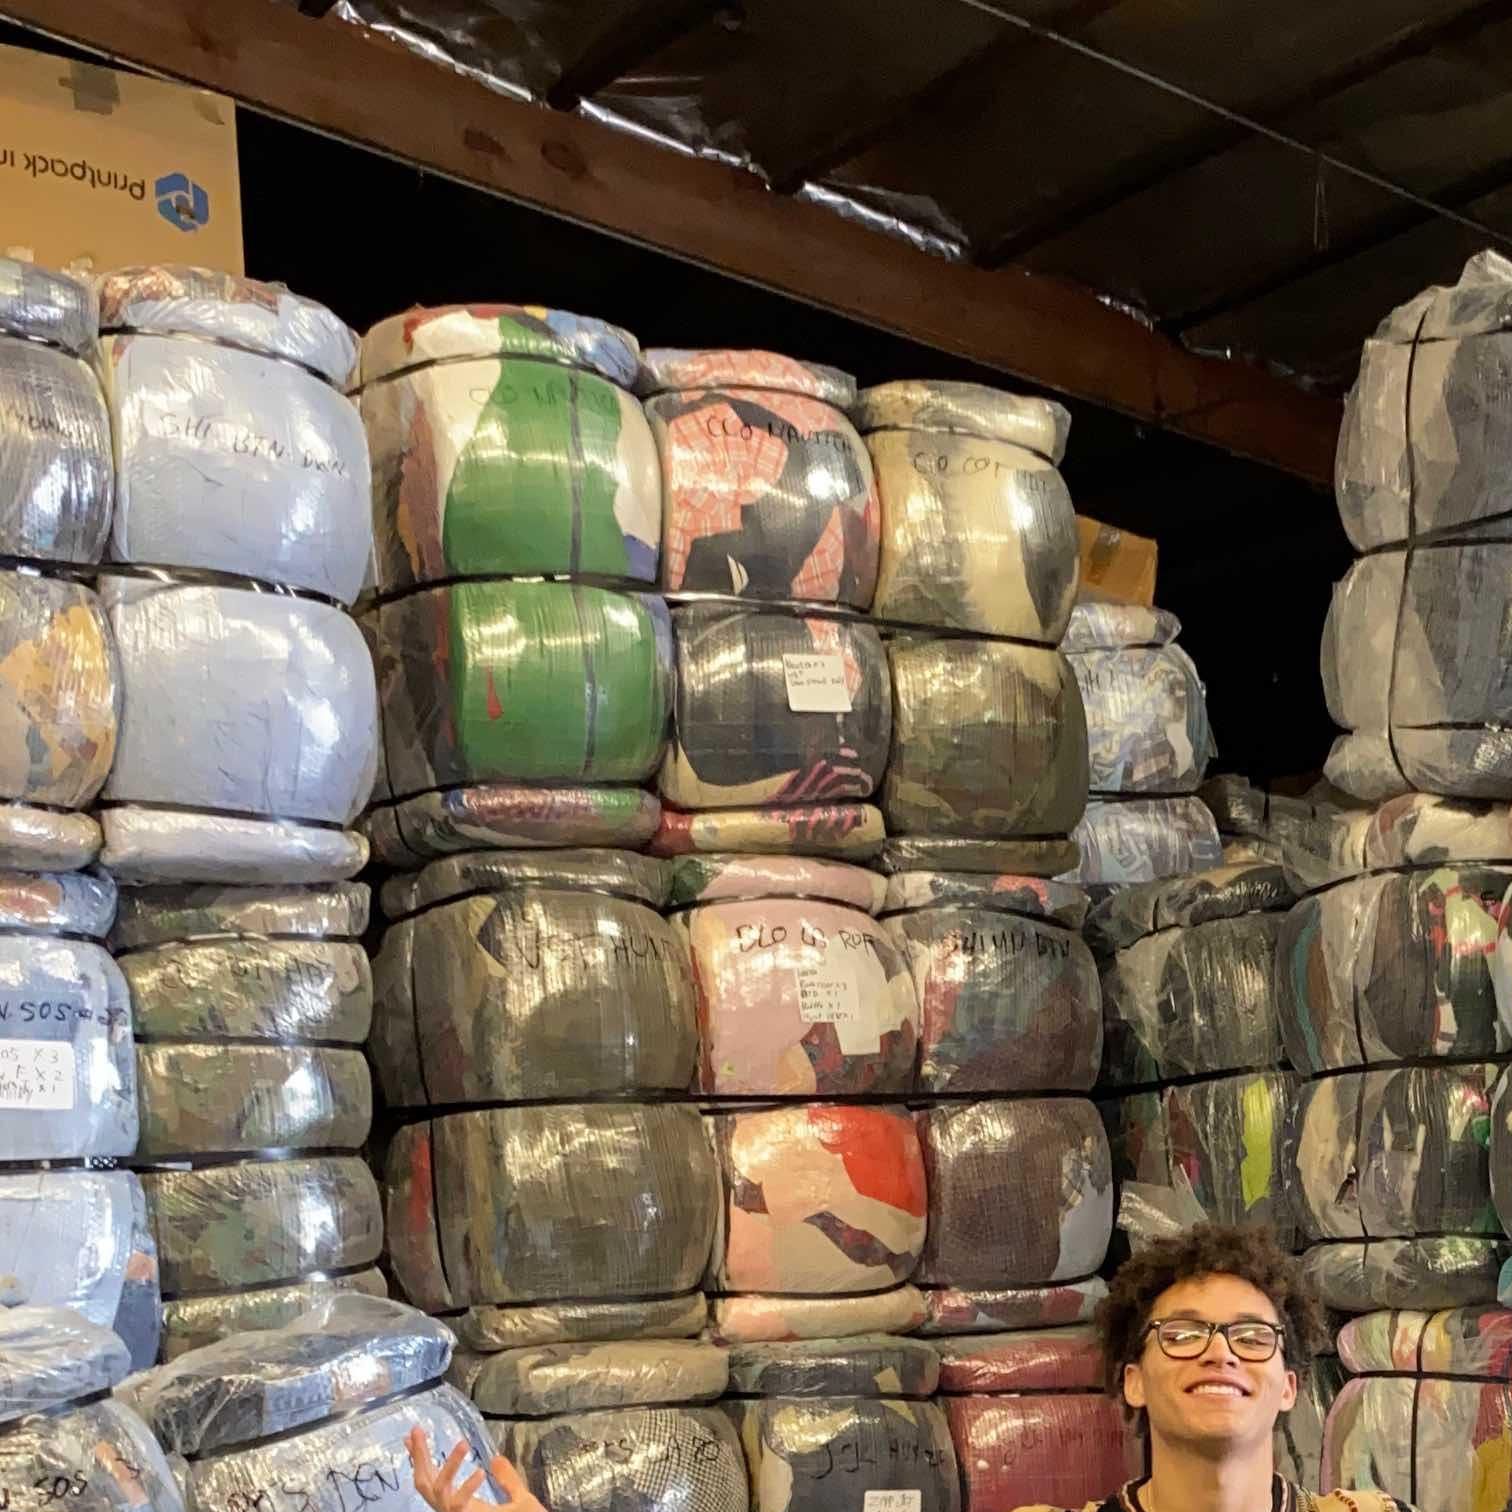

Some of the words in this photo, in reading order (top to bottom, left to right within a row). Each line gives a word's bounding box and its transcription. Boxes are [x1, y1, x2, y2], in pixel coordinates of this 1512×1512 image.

[24, 152, 146, 201] Printpack
[23, 1002, 71, 1022] SOS
[34, 1470, 88, 1506] SOS
